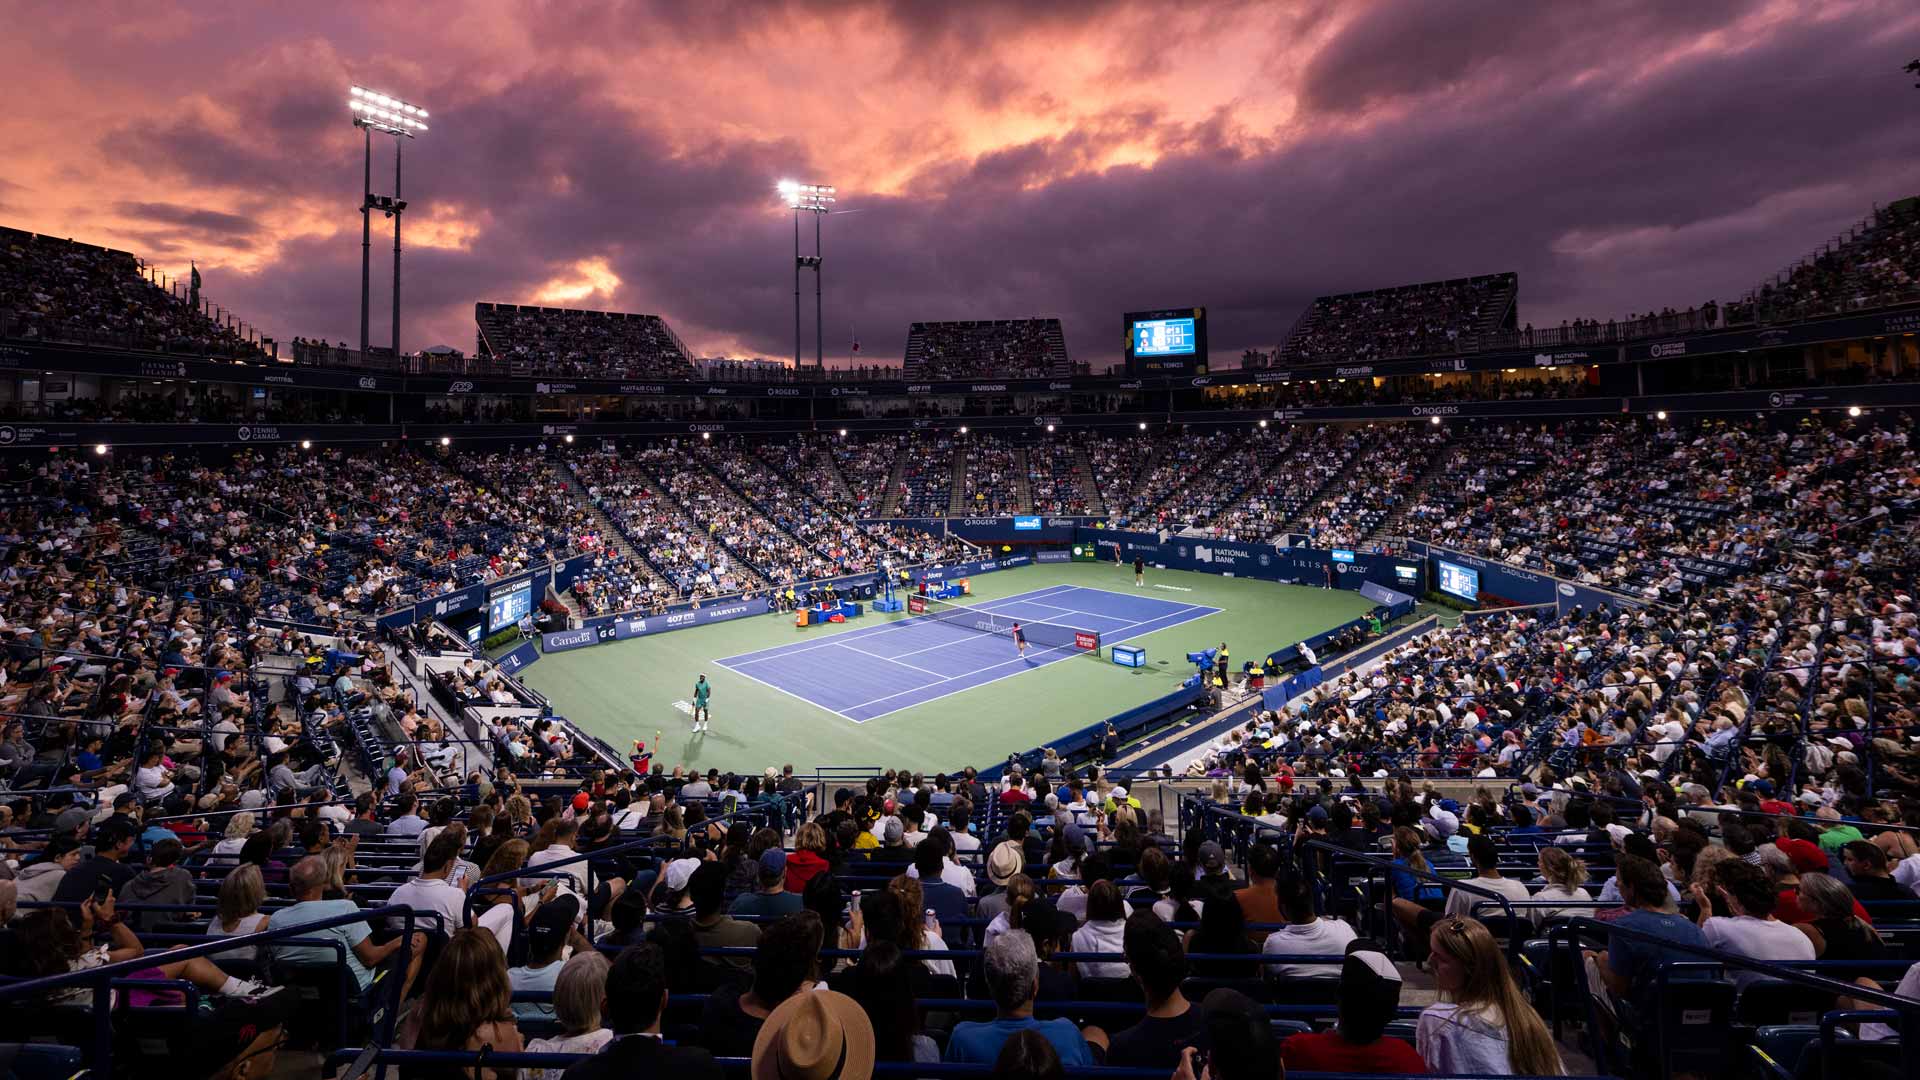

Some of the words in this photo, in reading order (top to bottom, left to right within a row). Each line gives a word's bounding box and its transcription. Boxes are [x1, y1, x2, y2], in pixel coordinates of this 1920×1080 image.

[1554, 351, 1589, 359] NATIONAL
[1336, 366, 1373, 375] Pizzaville
[1422, 406, 1459, 414] ROGERS
[1214, 548, 1250, 558] NATIONAL
[1215, 556, 1235, 564] BANK
[1348, 565, 1368, 573] razr
[1501, 566, 1538, 582] CADILLAC
[490, 587, 511, 597] CADILLAC
[516, 580, 531, 588] ROGERS
[710, 606, 747, 617] HARVEY'S
[667, 615, 683, 623] 407
[600, 630, 607, 638] G
[608, 628, 615, 636] G
[551, 632, 590, 647] Canada
